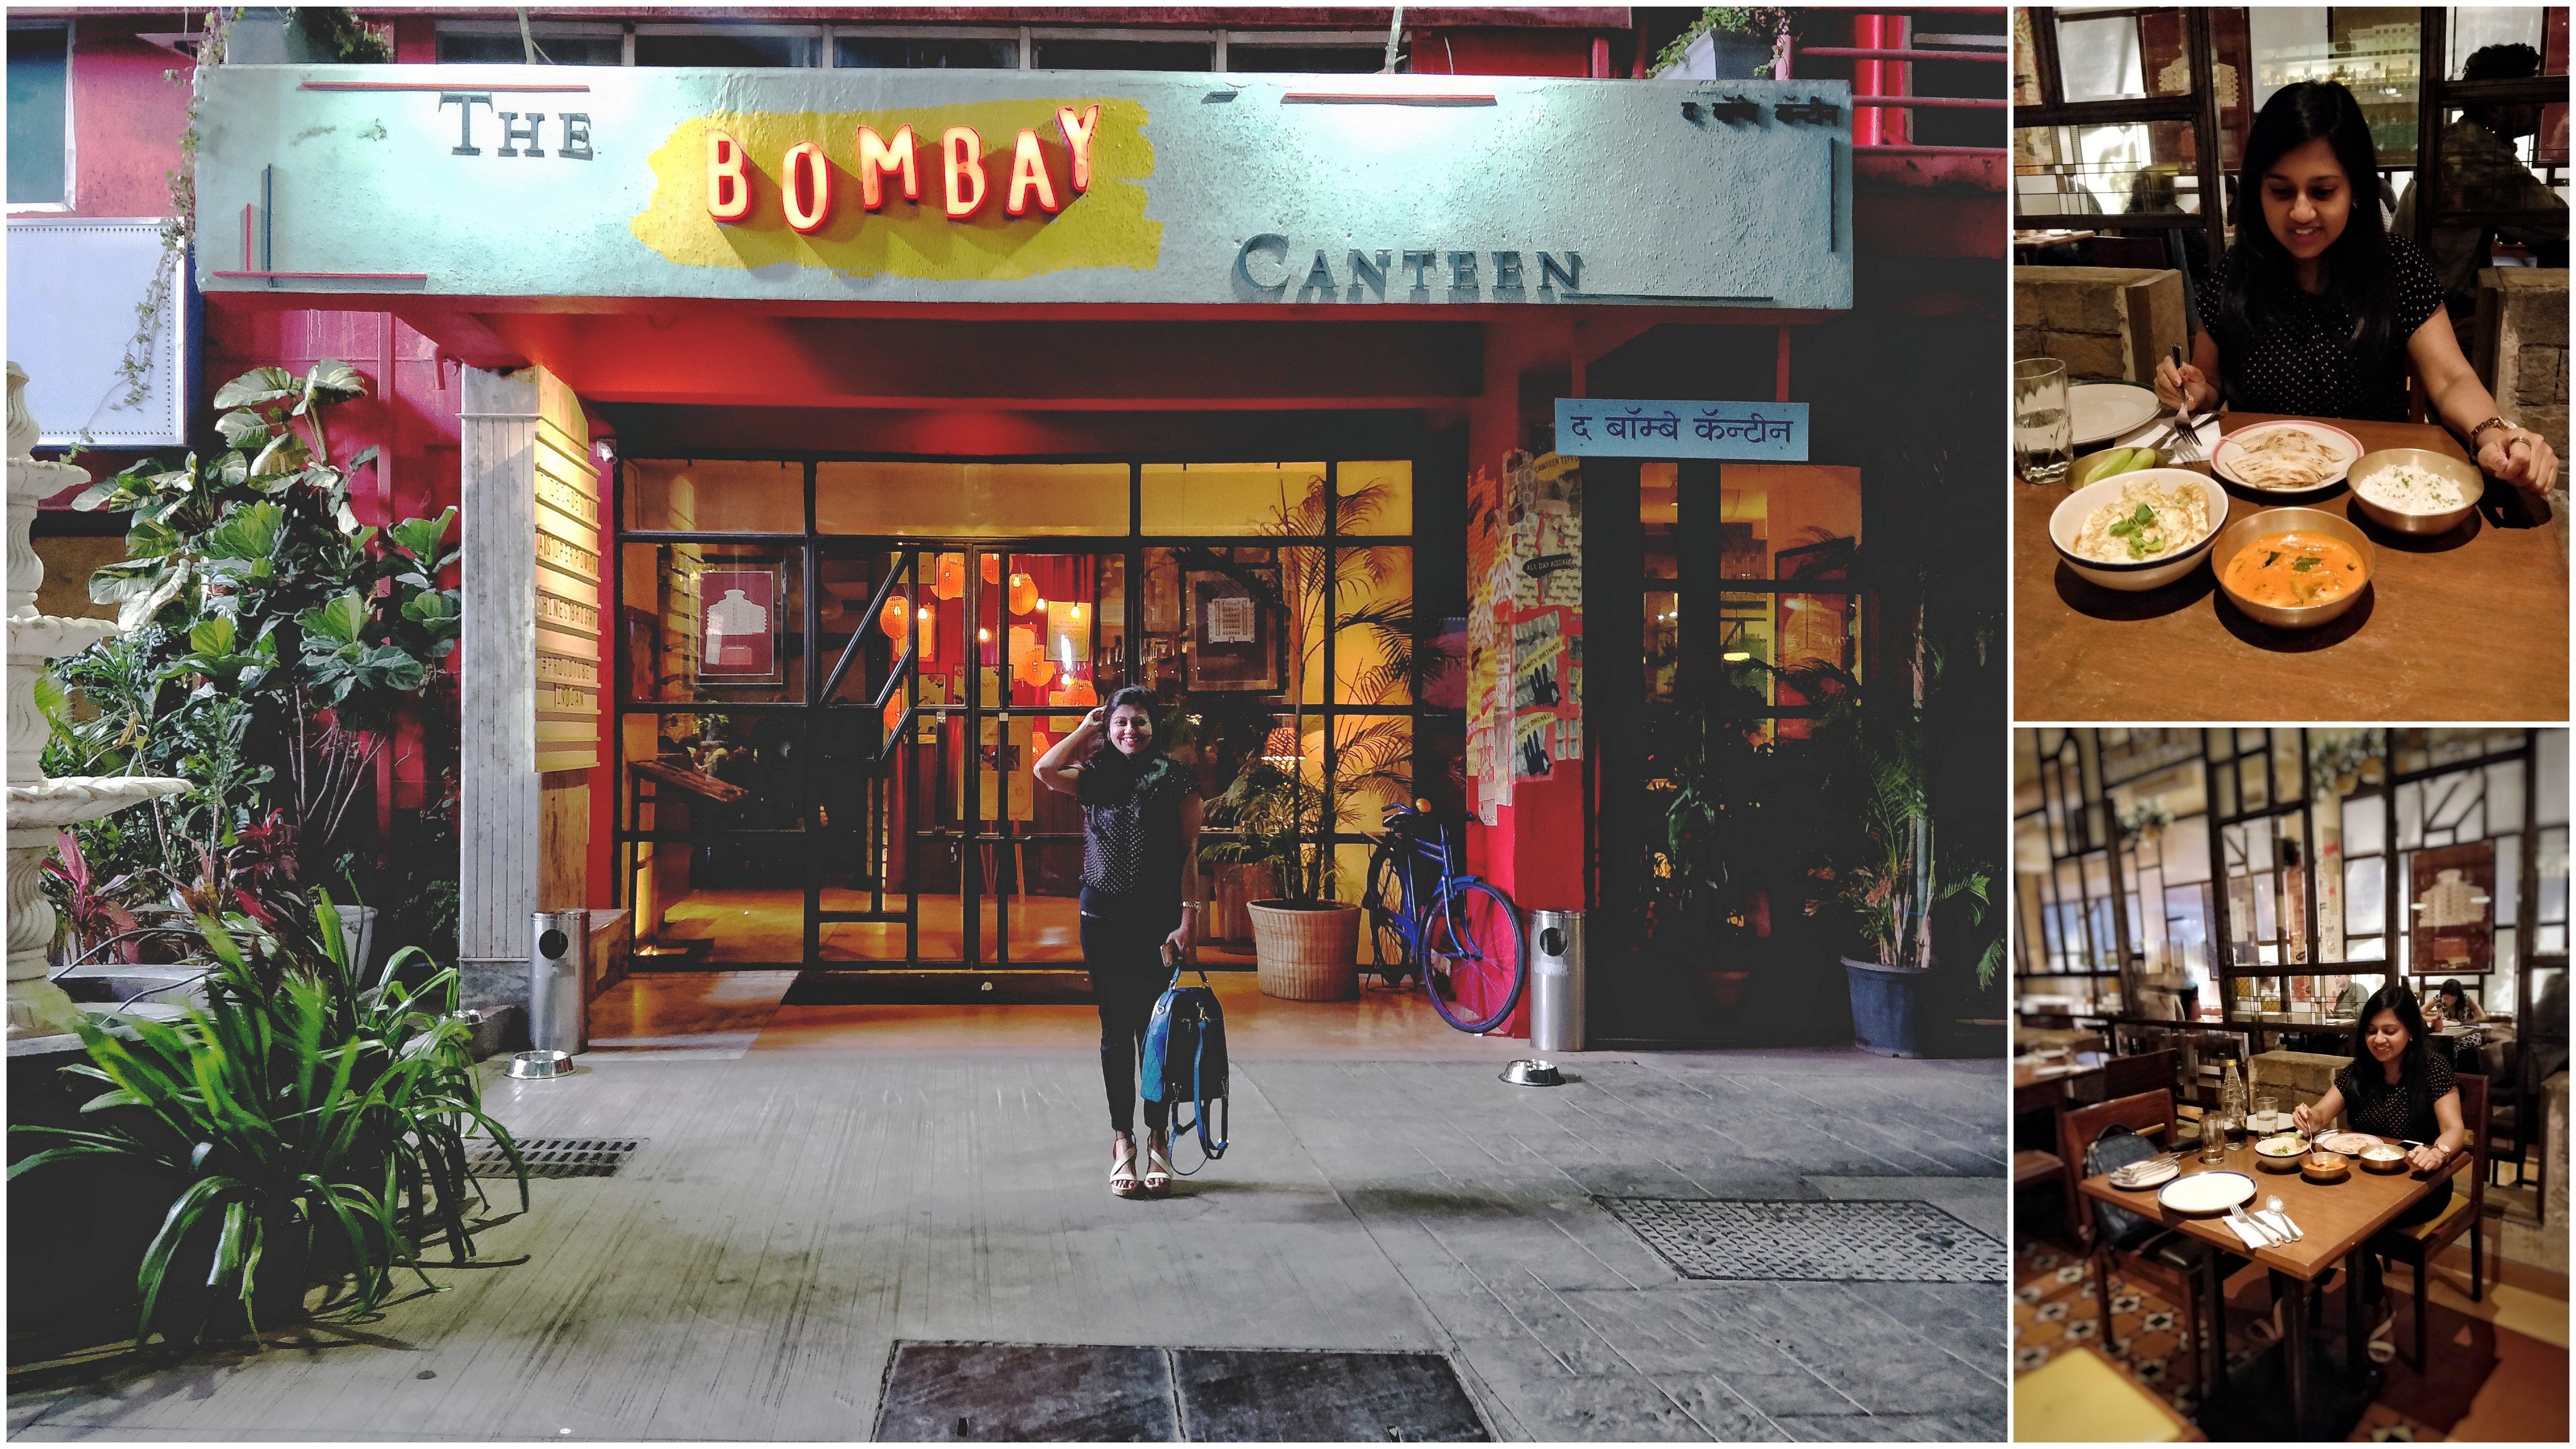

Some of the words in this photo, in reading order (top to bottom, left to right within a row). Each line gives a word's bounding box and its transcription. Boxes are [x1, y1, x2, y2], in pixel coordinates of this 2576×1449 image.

[704, 103, 1100, 235] BOMBAY
[1232, 231, 1586, 301] CANTEEN
[1570, 415, 1592, 441] द
[1534, 457, 1559, 473] CANTEEN
[1539, 561, 1550, 570] DAY
[1519, 657, 1538, 673] FANCY
[556, 687, 584, 708] INDIAN
